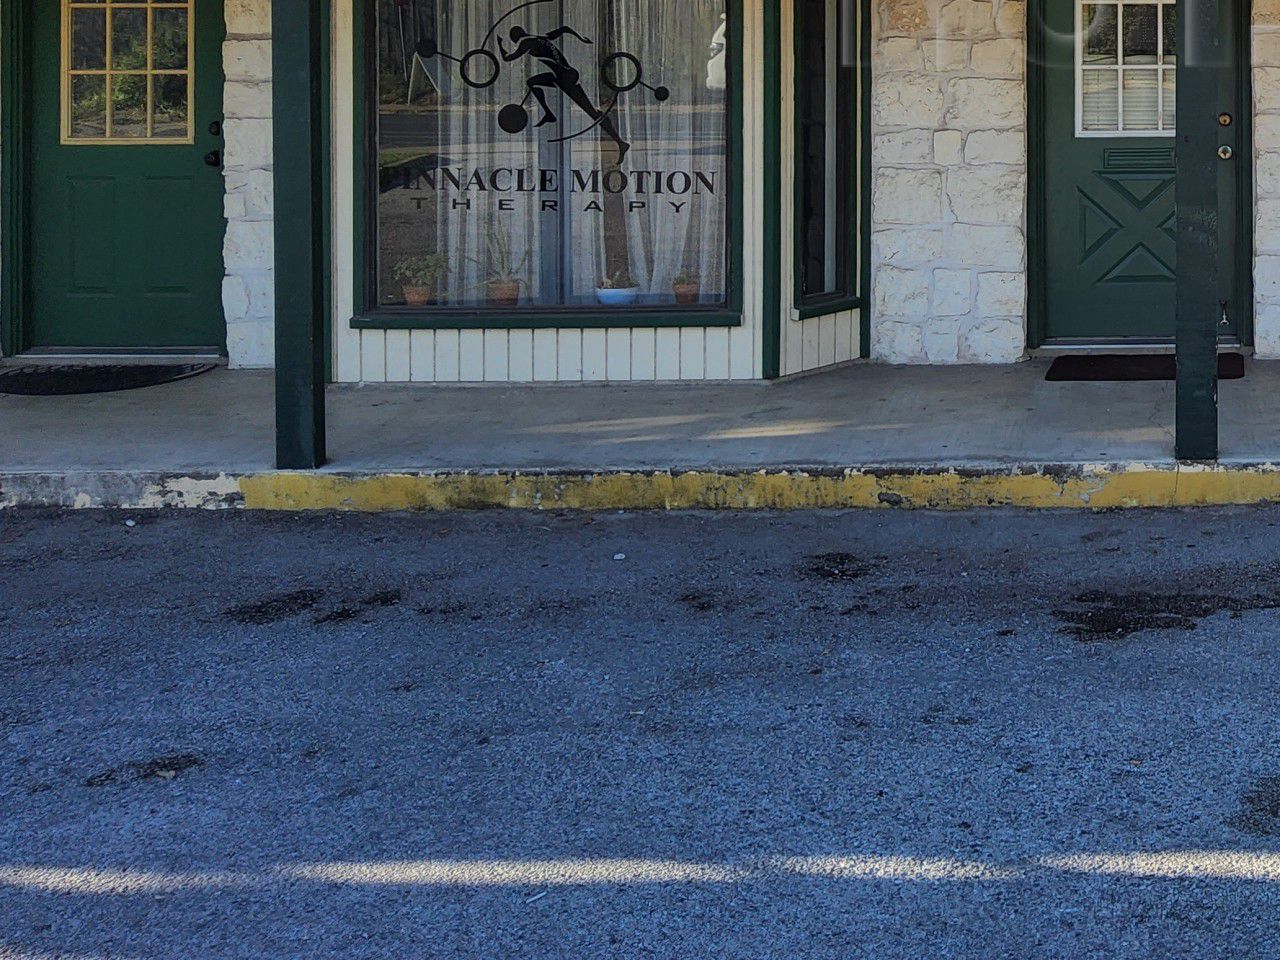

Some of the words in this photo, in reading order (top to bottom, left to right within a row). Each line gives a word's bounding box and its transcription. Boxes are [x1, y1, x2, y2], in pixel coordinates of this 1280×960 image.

[382, 166, 560, 192] INNACLE
[571, 169, 718, 195] MOTION
[410, 196, 687, 213] THERAPY
